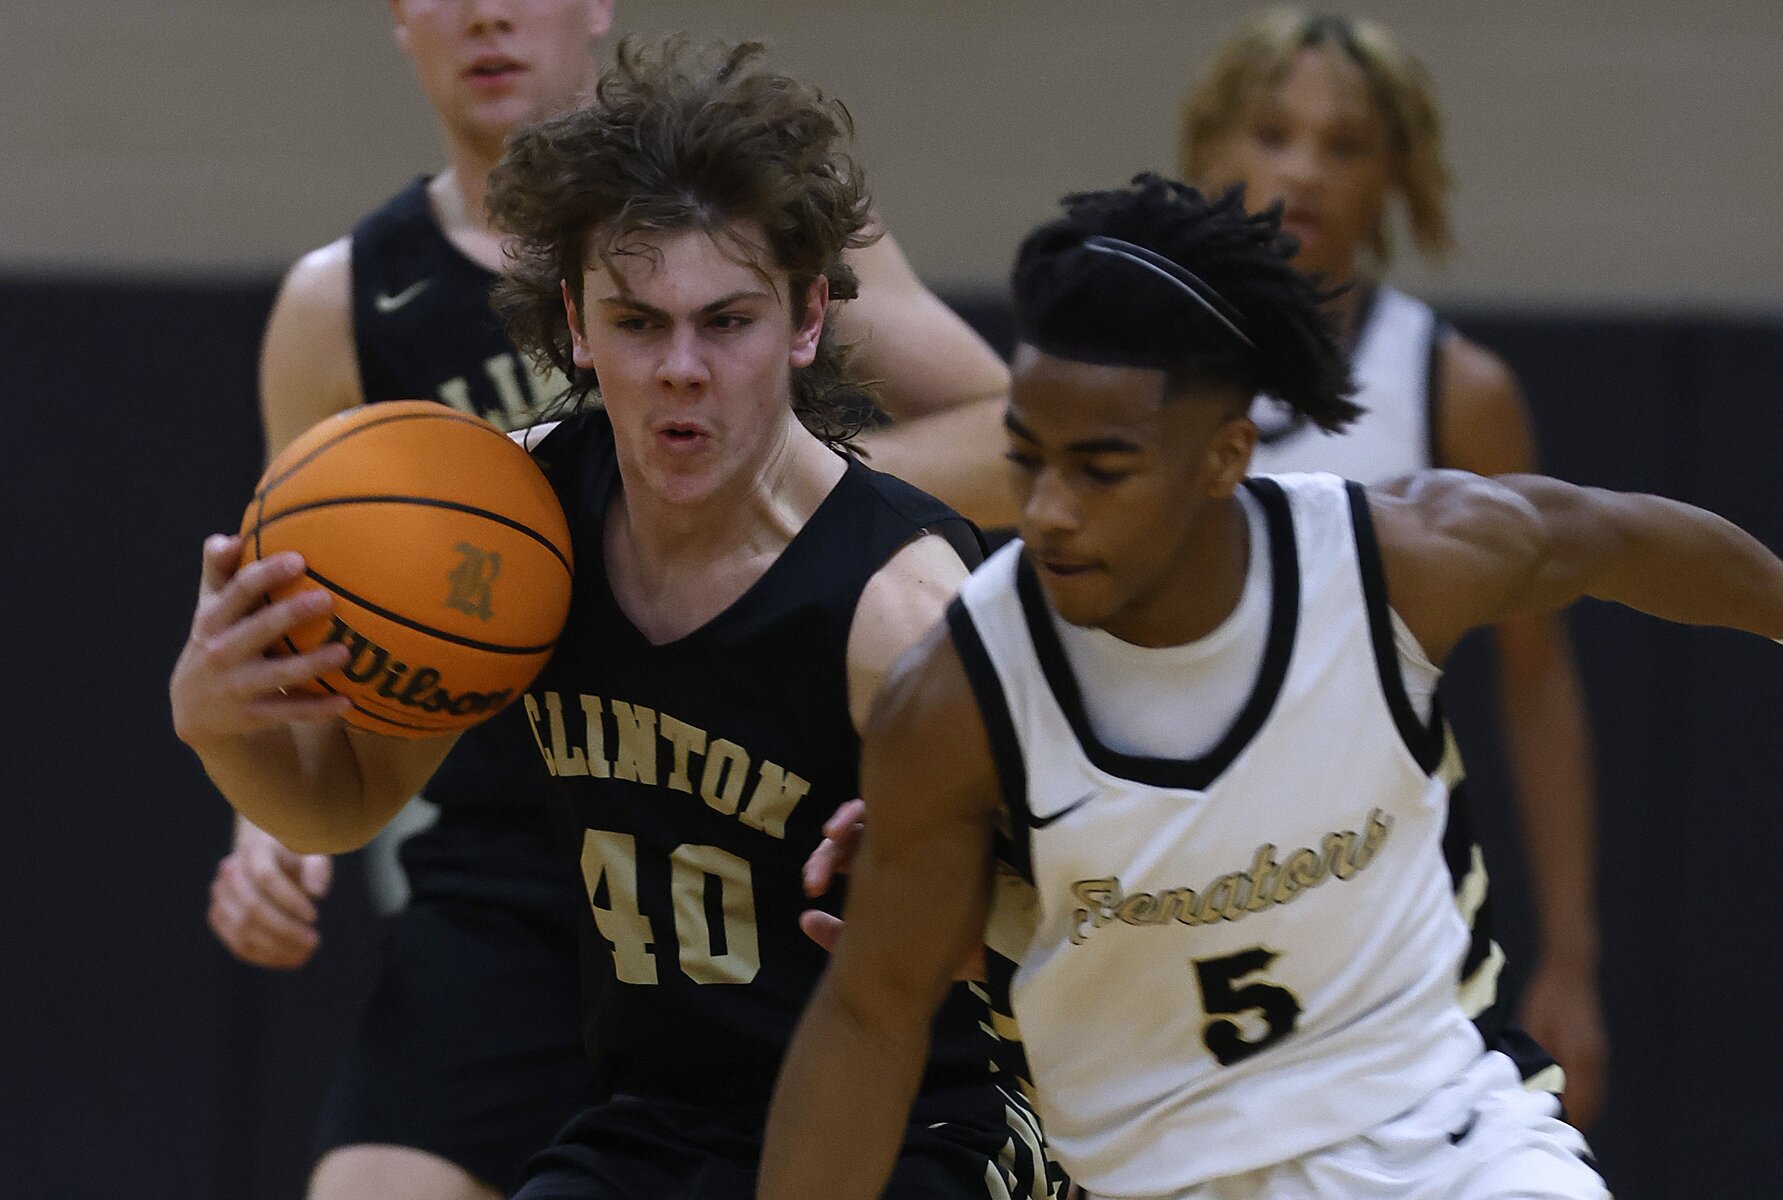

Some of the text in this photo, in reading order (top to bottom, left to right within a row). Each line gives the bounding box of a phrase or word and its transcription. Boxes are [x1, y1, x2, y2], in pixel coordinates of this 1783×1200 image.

[325, 614, 516, 716] Wilson
[524, 691, 812, 840] CLINTON
[580, 828, 761, 985] 40
[1071, 807, 1395, 946] Senators
[1192, 946, 1303, 1067] 5
